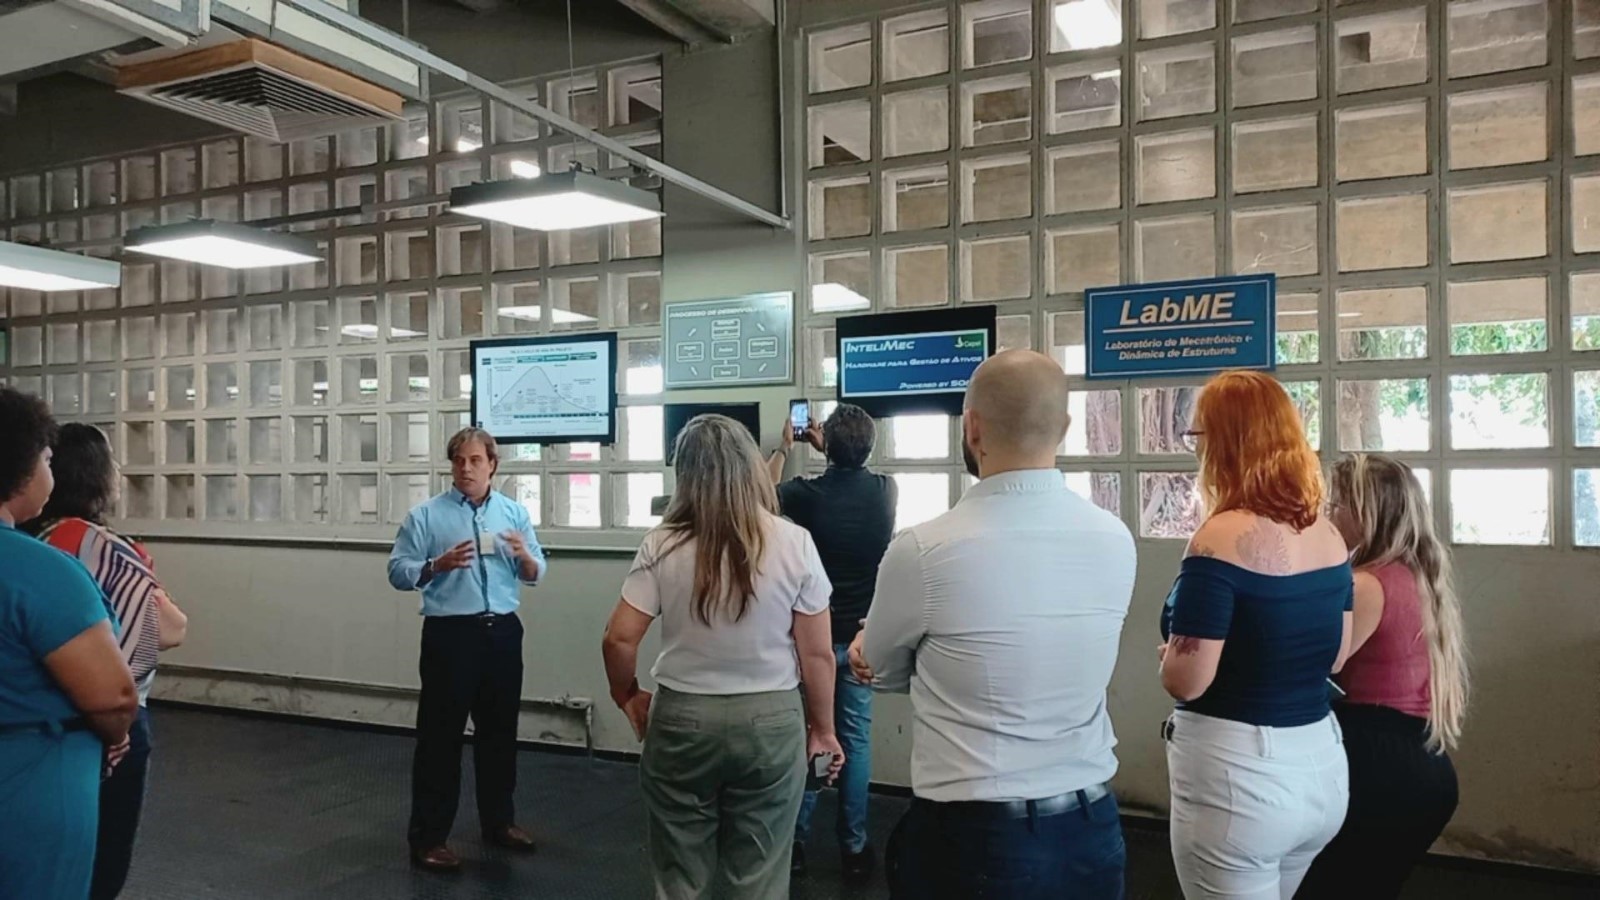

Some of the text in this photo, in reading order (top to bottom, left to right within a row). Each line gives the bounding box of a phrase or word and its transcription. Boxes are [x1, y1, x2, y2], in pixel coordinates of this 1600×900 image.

[1119, 292, 1236, 325] LabME
[1105, 336, 1162, 351] Laboratório
[1164, 337, 1178, 347] de
[1119, 349, 1165, 361] Dinâmica
[1167, 348, 1180, 358] de
